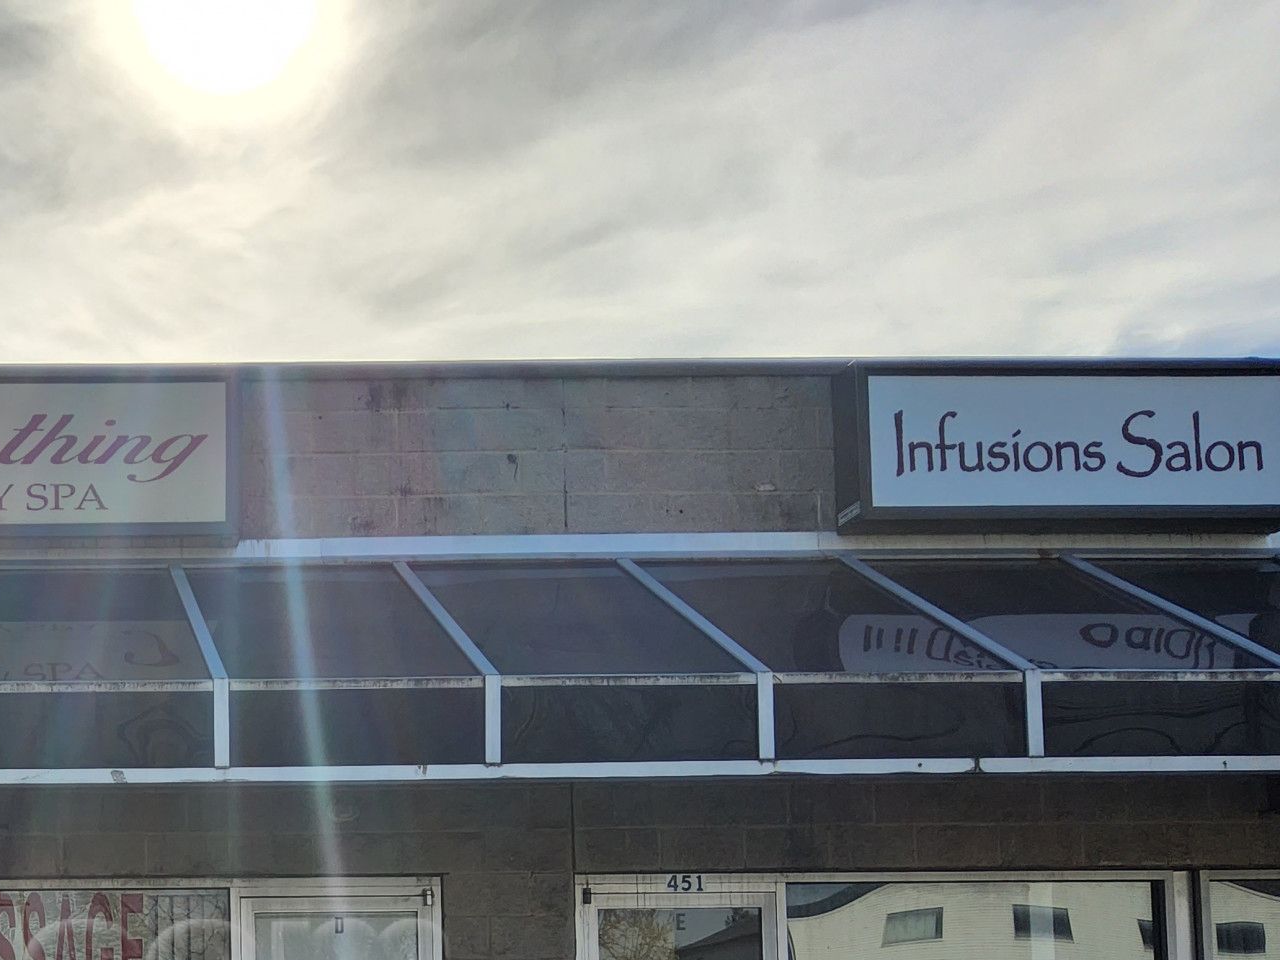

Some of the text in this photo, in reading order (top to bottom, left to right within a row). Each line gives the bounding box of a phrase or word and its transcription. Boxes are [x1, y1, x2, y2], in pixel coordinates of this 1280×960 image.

[894, 409, 1264, 478] Infusions Salon
[25, 482, 108, 512] SPA
[666, 874, 704, 892] 451
[334, 916, 344, 934] D
[676, 912, 686, 931] E
